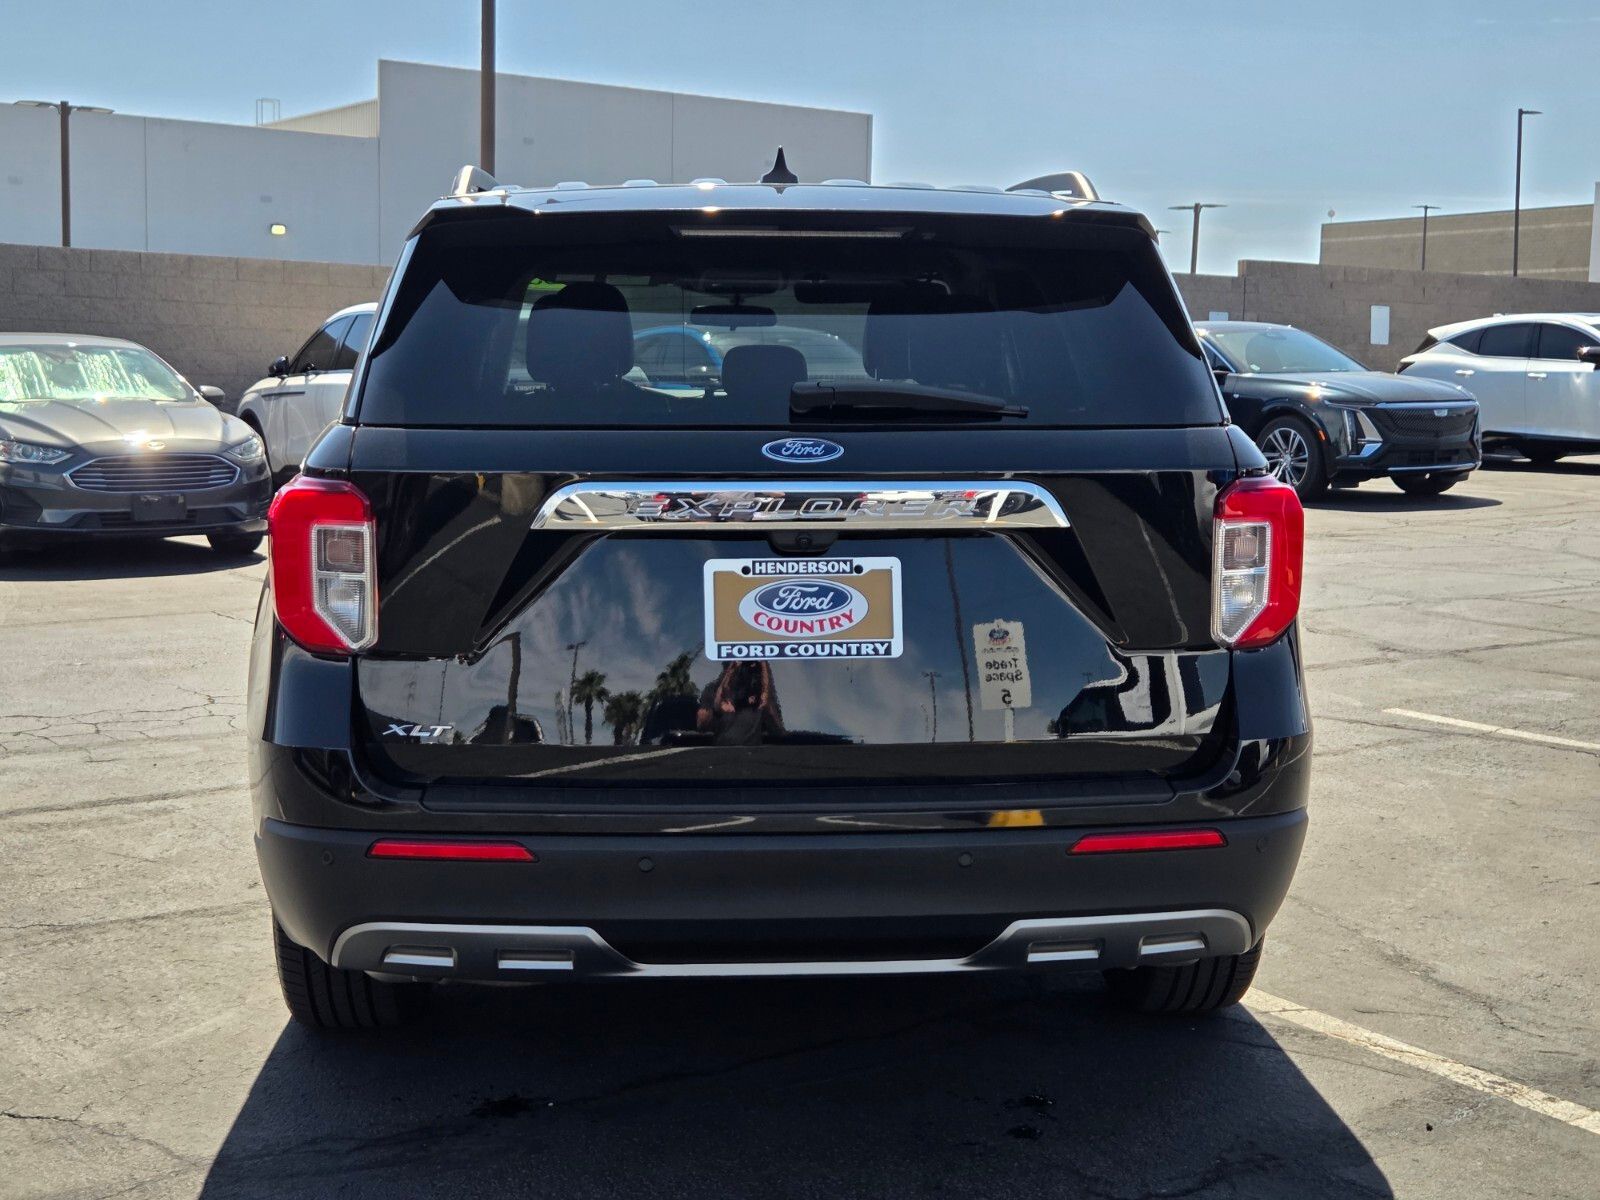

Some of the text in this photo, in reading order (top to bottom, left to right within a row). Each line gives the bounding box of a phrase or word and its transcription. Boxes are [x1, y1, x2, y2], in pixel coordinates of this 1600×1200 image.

[781, 440, 825, 456] Ford
[624, 497, 978, 517] EXPLORER
[754, 560, 851, 575] HENDERSON
[772, 586, 835, 611] Ford
[753, 608, 855, 635] COUNTRY
[720, 642, 890, 658] FORD COUNTRY
[382, 723, 453, 737] XLT
